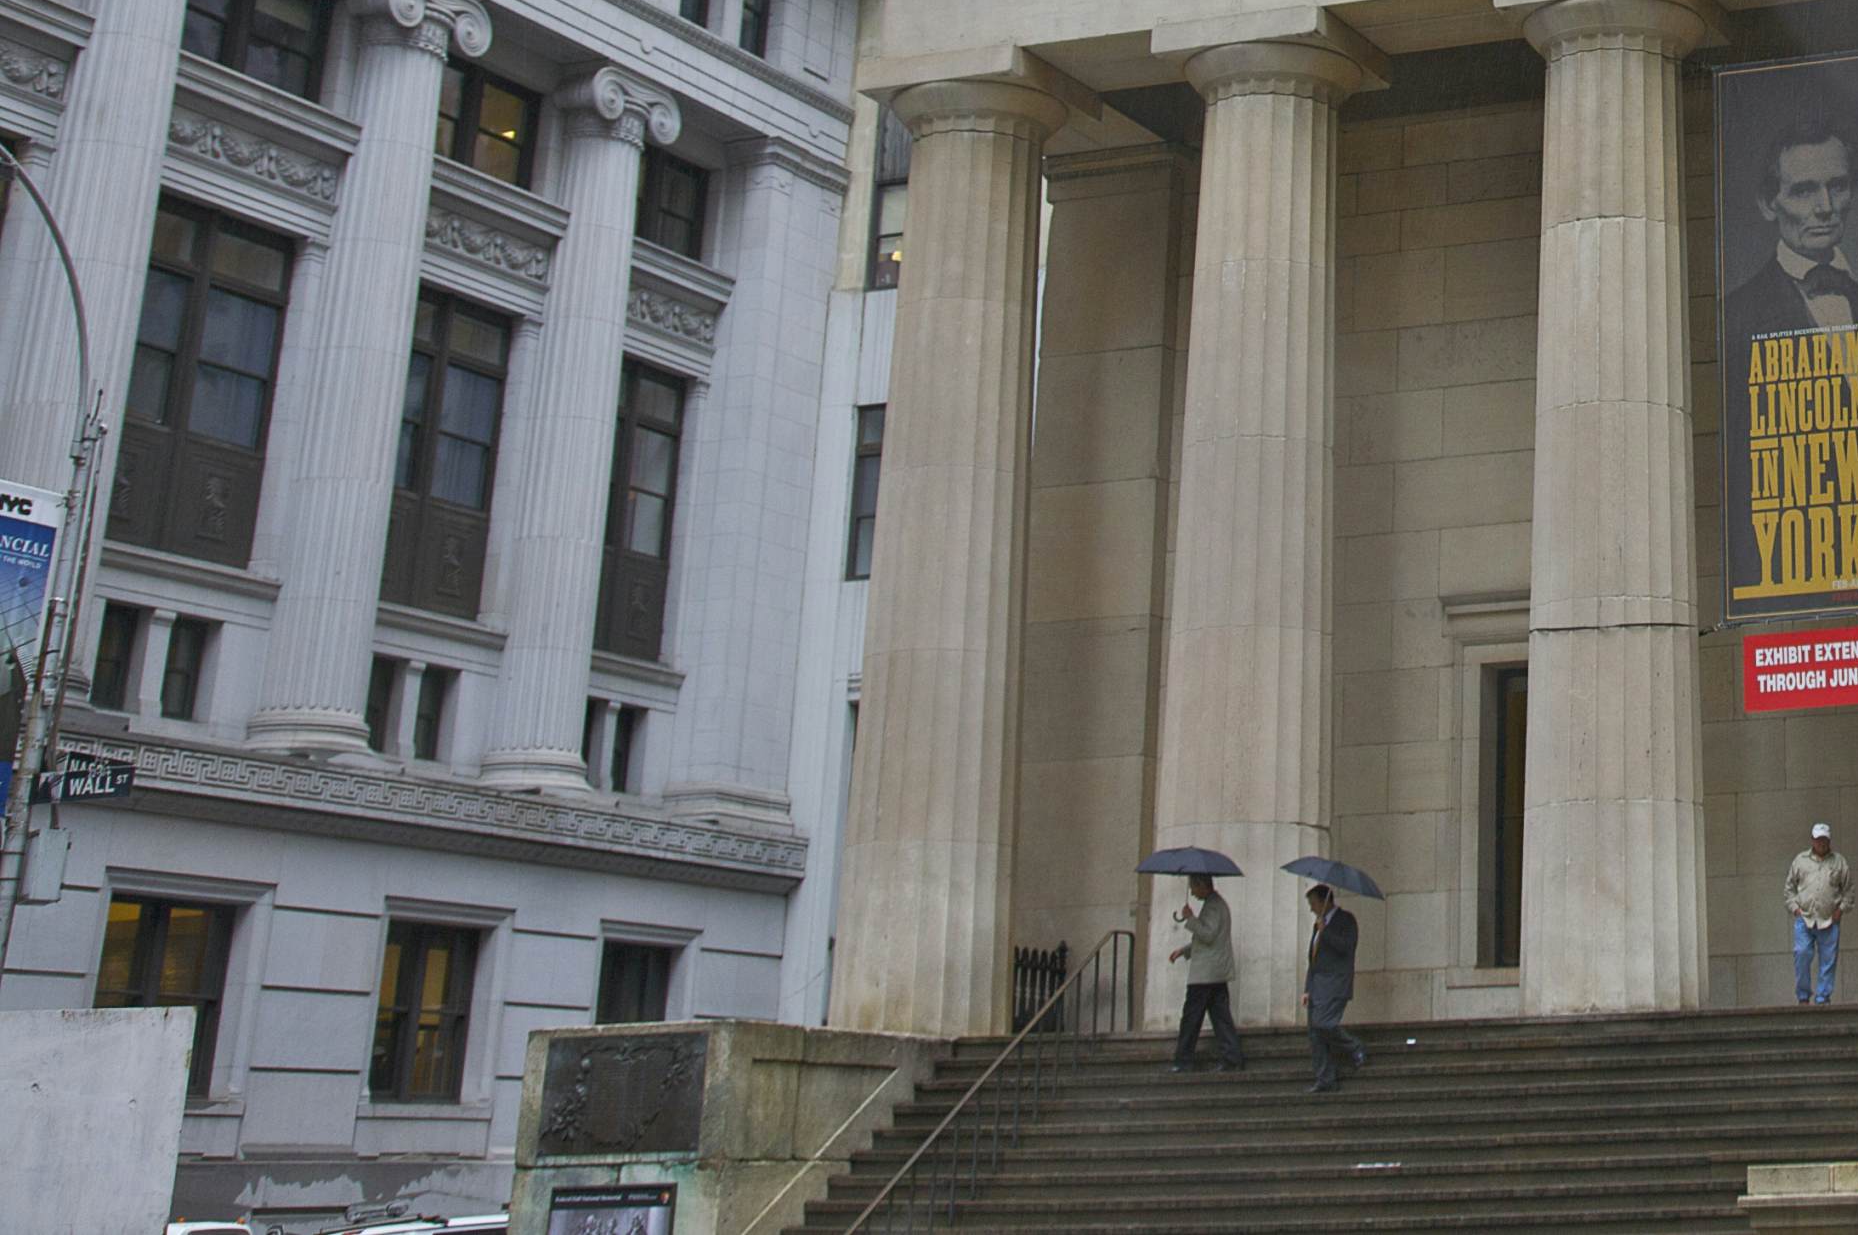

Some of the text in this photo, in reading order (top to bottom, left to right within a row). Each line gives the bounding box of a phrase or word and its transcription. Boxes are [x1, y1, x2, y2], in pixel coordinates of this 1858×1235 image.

[1751, 449, 1779, 499] IN
[0, 535, 50, 557] NCIAL
[1755, 644, 1811, 667] EXHIBIT
[1757, 670, 1826, 693] THROUGH
[69, 773, 128, 796] WALL ST
